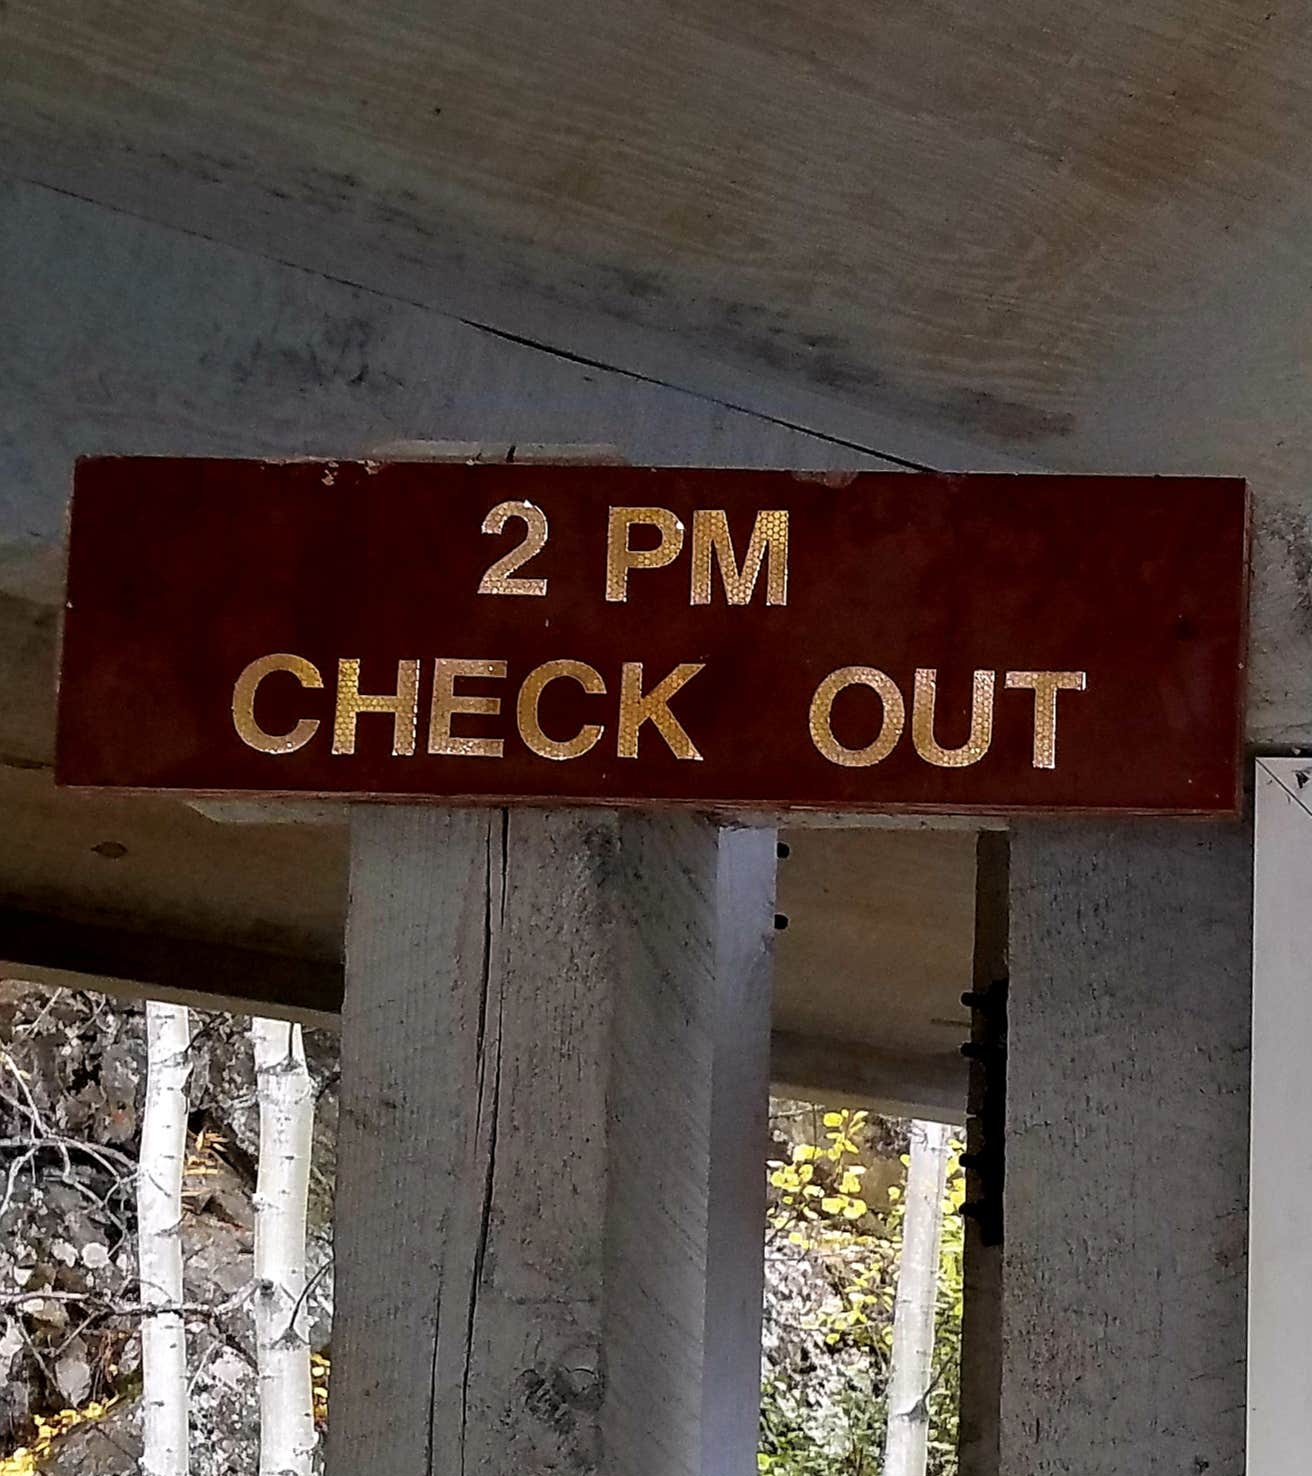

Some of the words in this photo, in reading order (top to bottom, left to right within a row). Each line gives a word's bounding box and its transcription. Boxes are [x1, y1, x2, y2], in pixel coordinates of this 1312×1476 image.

[477, 499, 549, 597] 2
[605, 505, 790, 607] PM
[230, 653, 707, 762] CHECK
[808, 665, 1087, 770] OUT
